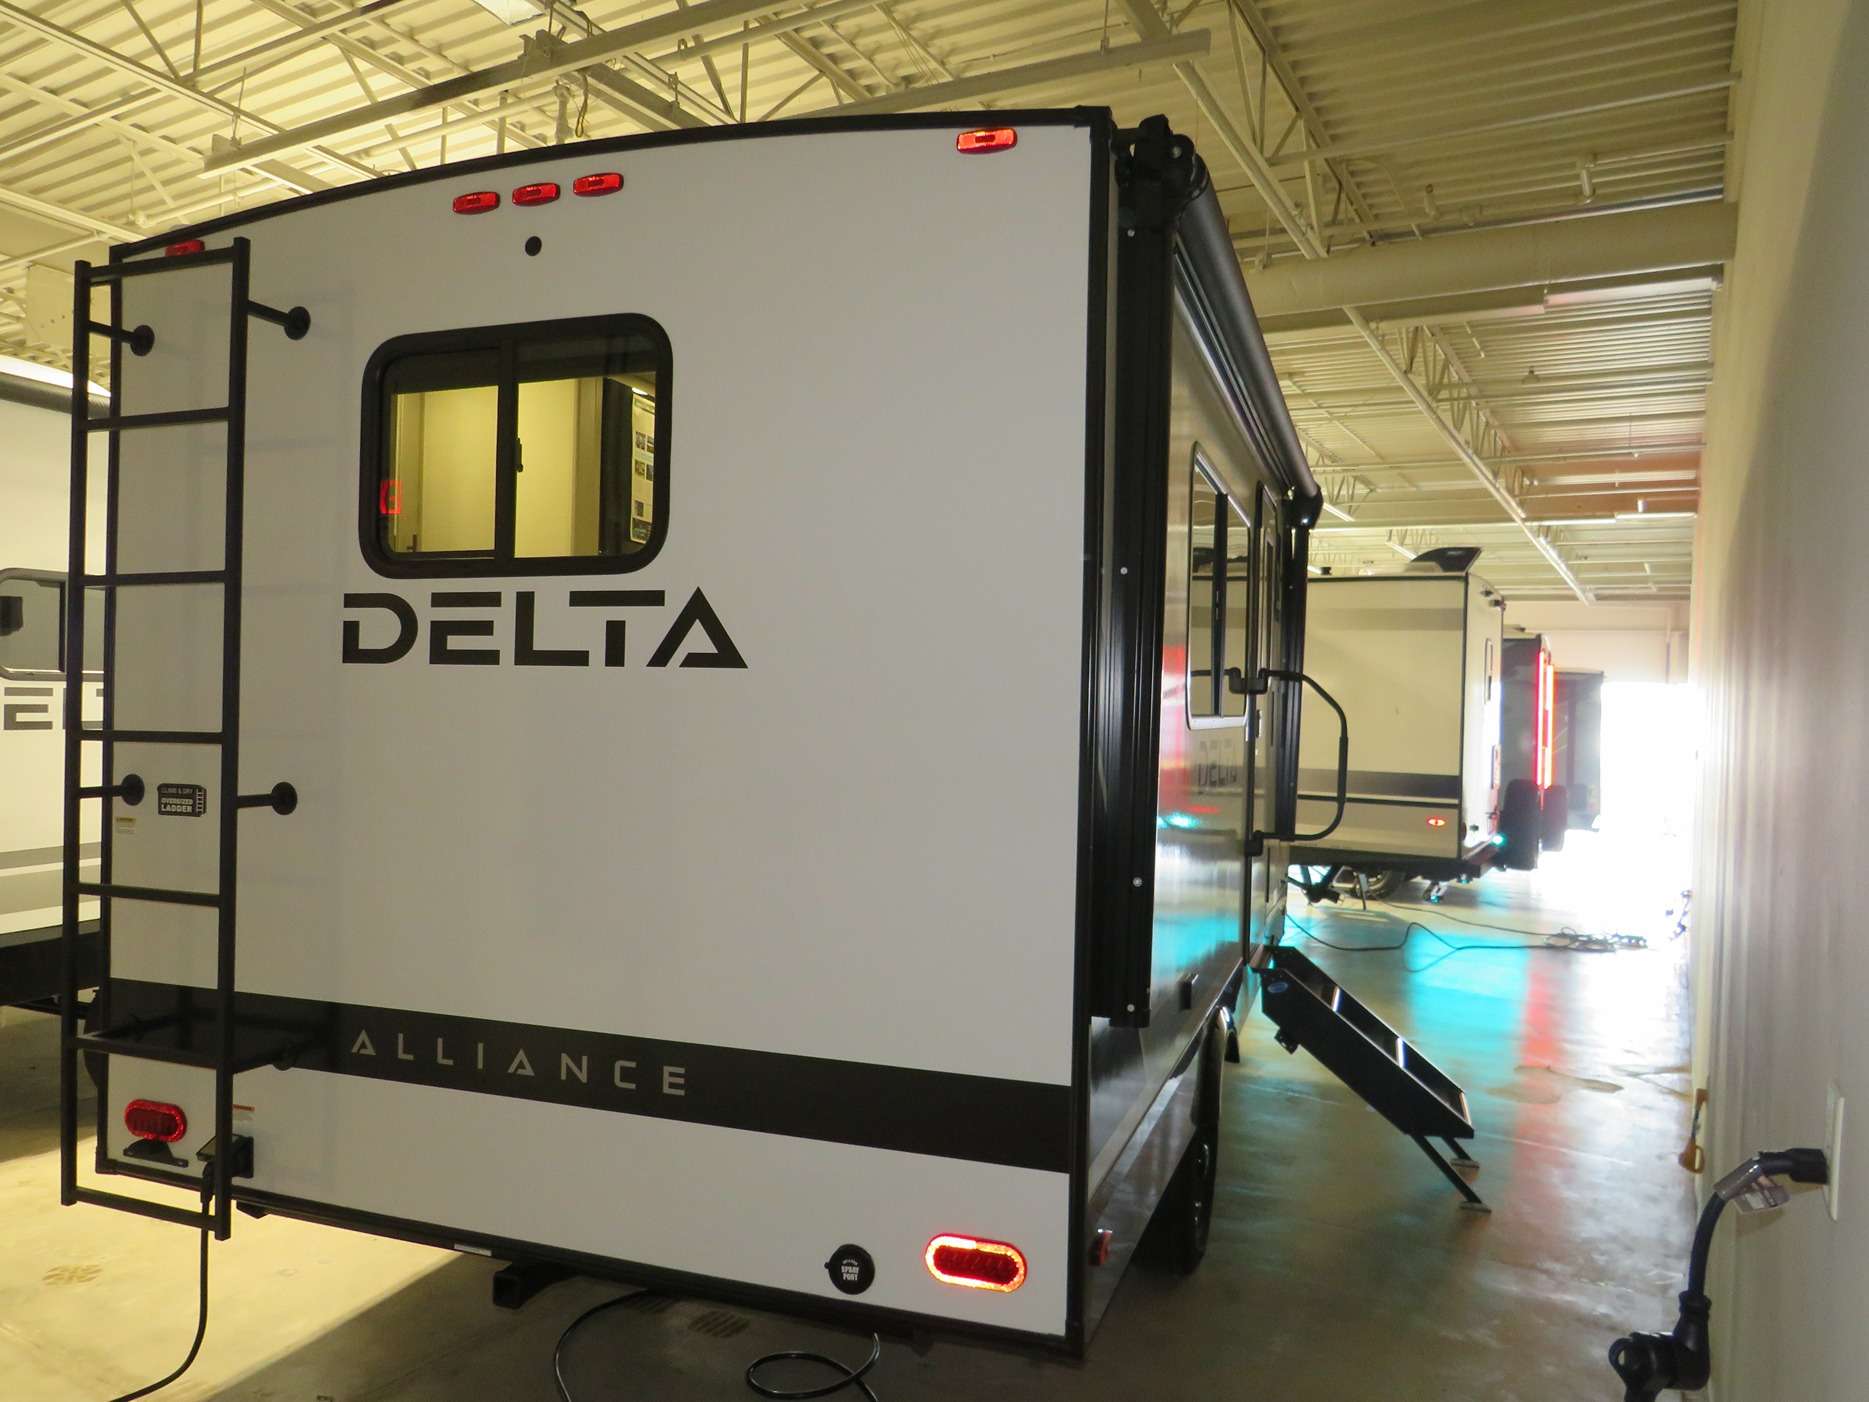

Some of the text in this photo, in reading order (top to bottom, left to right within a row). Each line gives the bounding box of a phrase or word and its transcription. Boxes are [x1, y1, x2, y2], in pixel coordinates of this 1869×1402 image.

[342, 586, 748, 668] DELTA
[161, 804, 193, 812] LADDER
[351, 1029, 686, 1096] ALLIANCE
